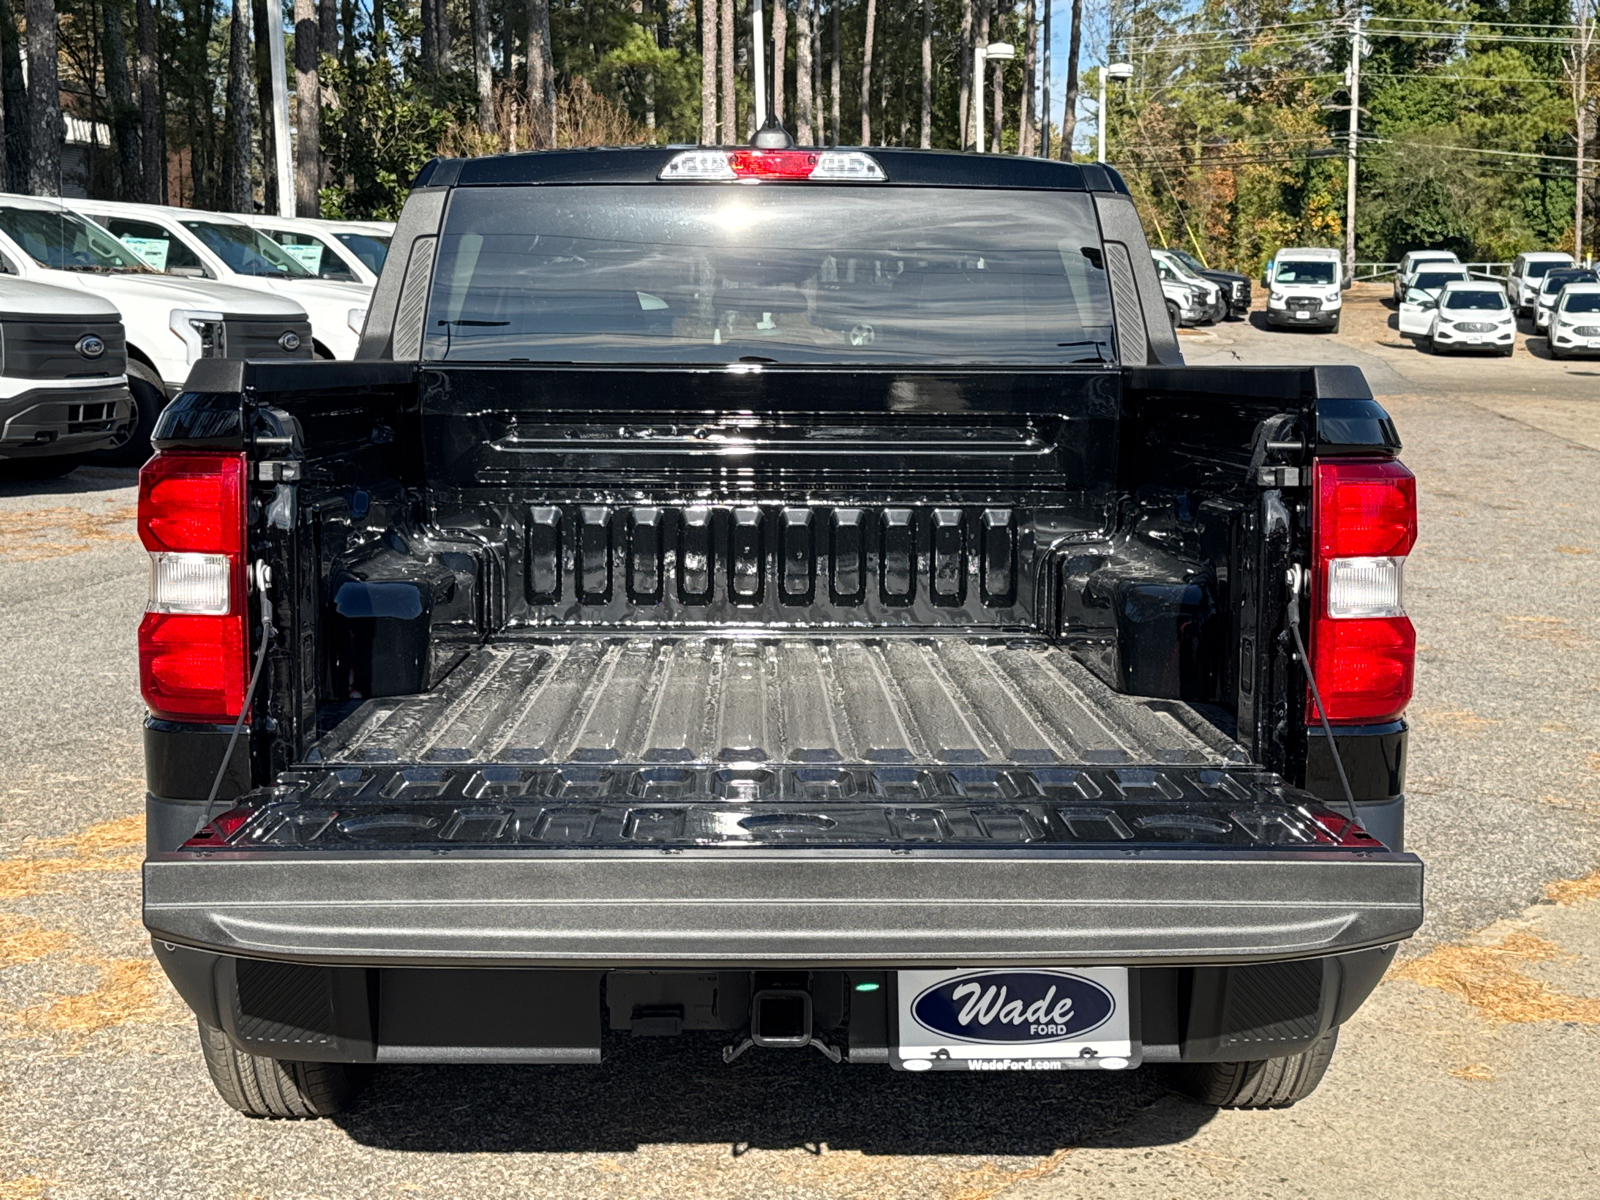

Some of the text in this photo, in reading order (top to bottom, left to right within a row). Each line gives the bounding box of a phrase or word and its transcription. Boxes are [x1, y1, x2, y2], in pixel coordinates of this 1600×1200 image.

[952, 982, 1075, 1026] Wade
[1030, 1024, 1067, 1035] FORD
[968, 1059, 1062, 1071] WadeFord.com
